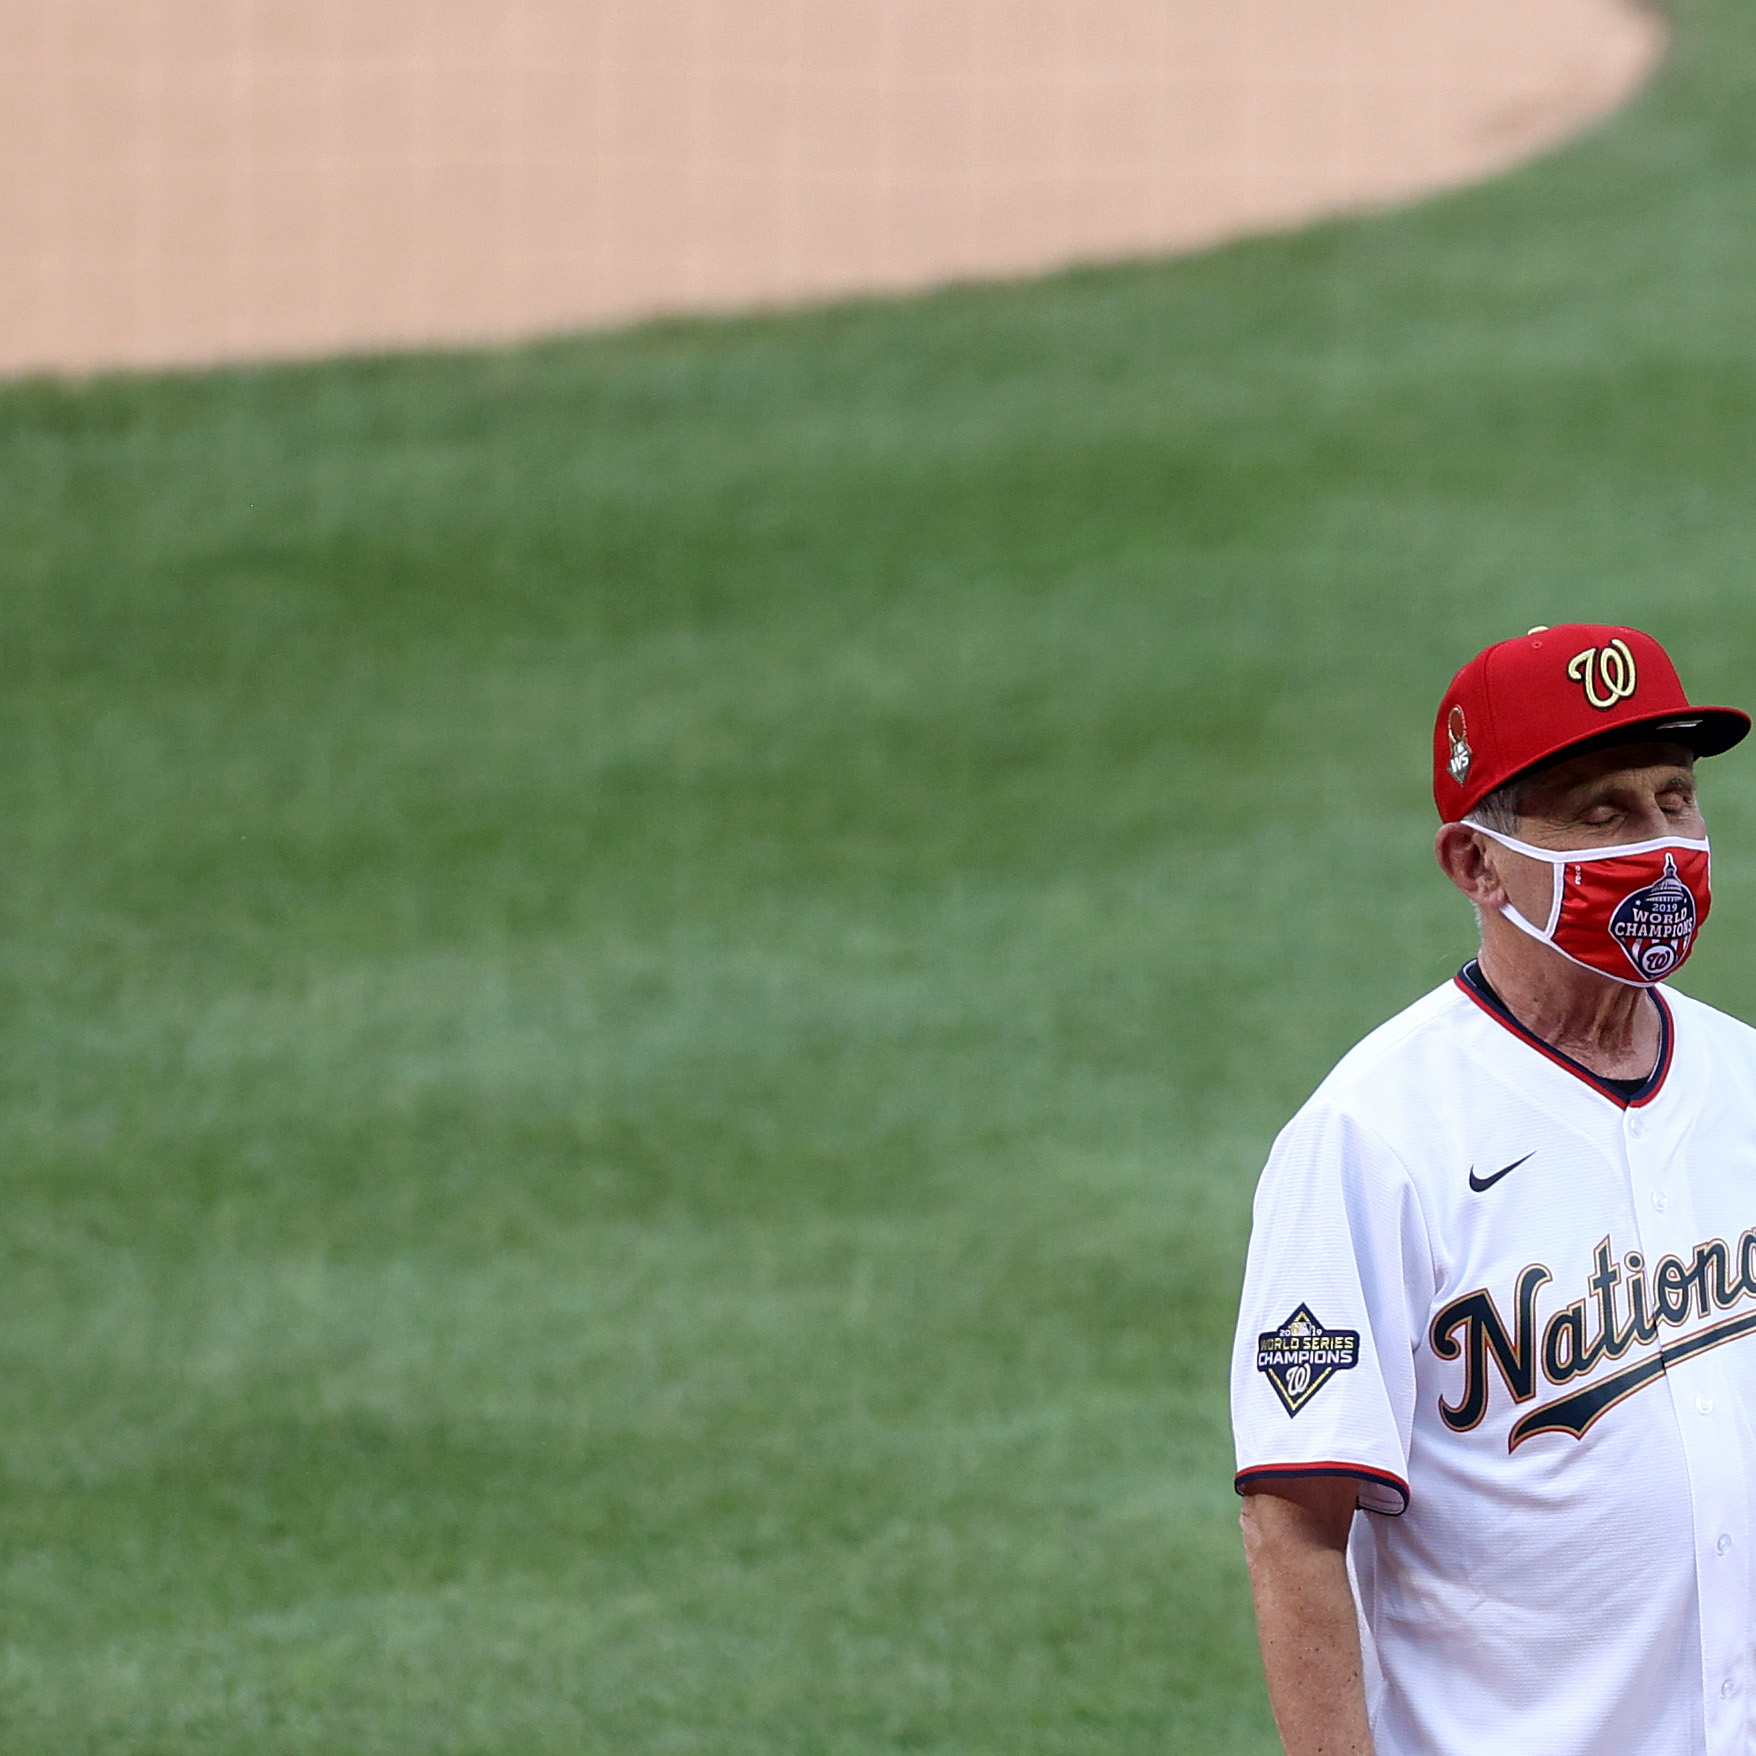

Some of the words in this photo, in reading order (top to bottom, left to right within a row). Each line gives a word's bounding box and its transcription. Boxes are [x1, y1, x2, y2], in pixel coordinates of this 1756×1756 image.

[1566, 637, 1637, 710] W
[1450, 753, 1470, 774] WS
[1632, 907, 1688, 925] WORLD
[1651, 903, 1678, 913] 2019
[1614, 916, 1694, 937] CHAMPIONS
[1260, 1337, 1300, 1351] WORLD
[1302, 1336, 1355, 1350] SERIES
[1258, 1349, 1353, 1366] CHAMPIONS
[1285, 1362, 1312, 1396] W
